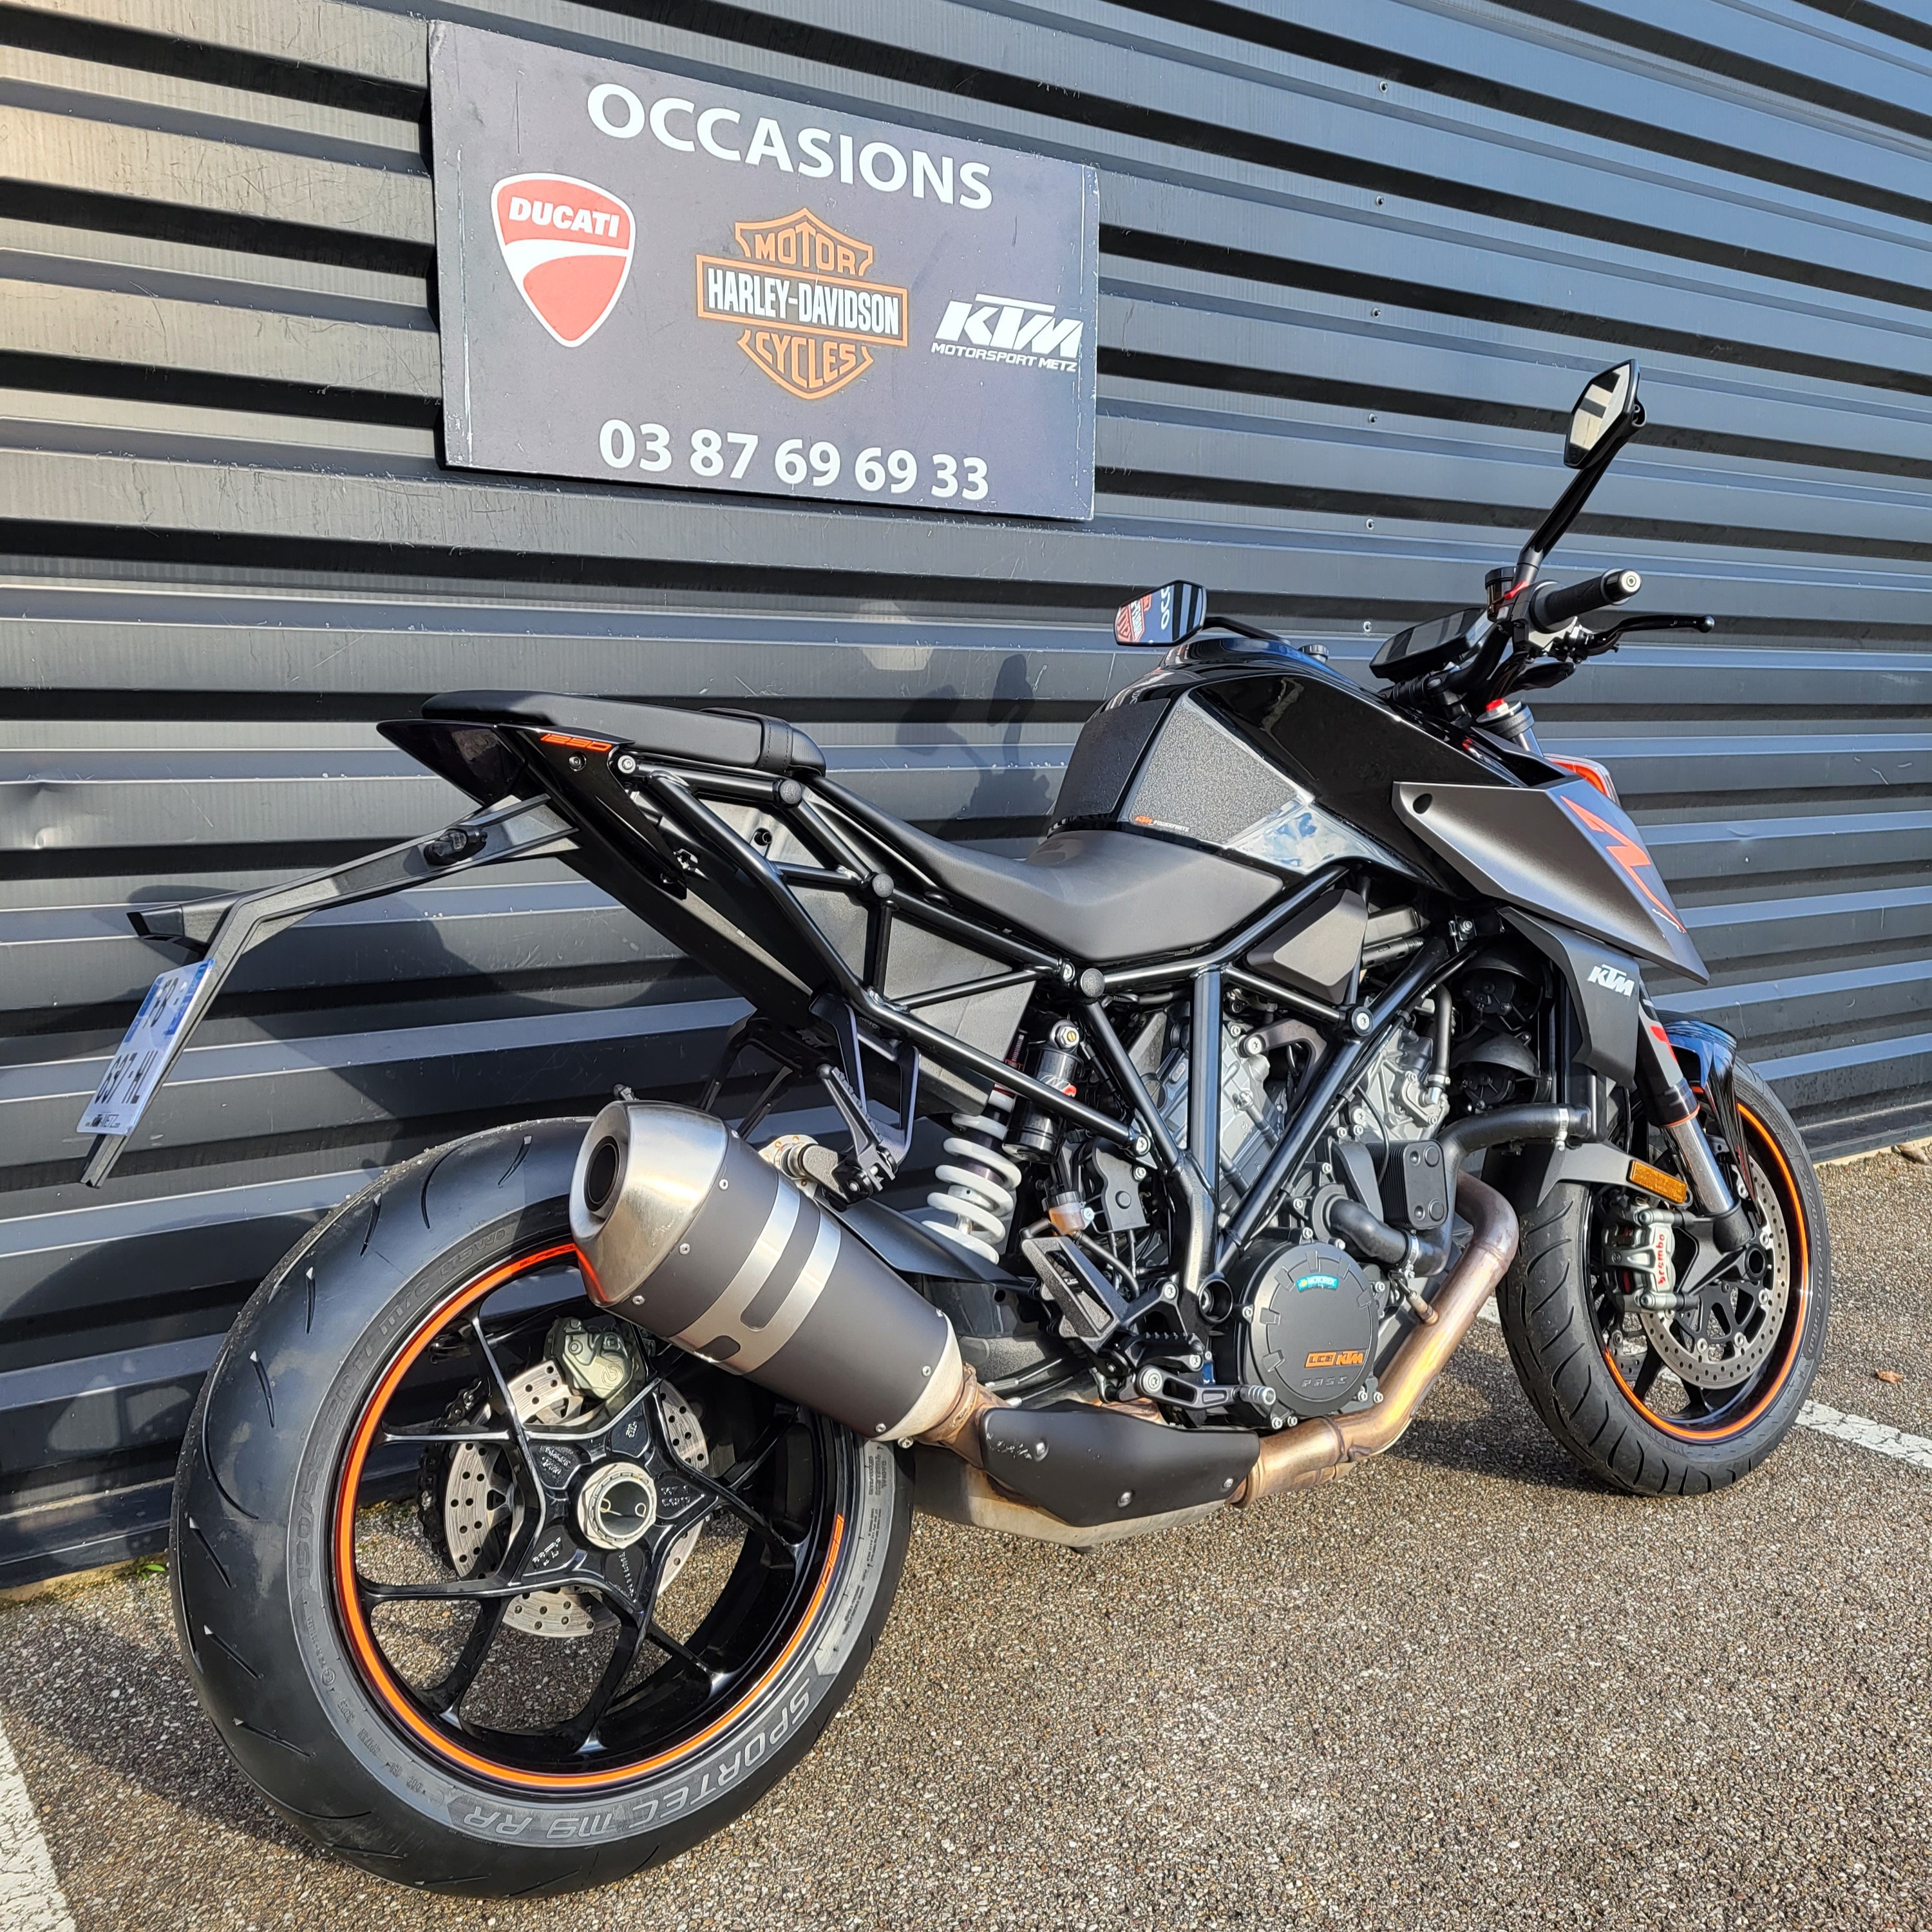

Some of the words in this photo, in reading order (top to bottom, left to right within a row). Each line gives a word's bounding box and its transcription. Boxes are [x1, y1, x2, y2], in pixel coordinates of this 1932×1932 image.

[587, 83, 994, 210] OCCASIONS
[508, 196, 620, 238] DUCATI
[754, 221, 856, 275] MOTOR
[708, 267, 899, 335] HARLEY-DAVIDSON
[935, 293, 1084, 359] KTM
[755, 331, 856, 388] CYCLES
[931, 342, 1037, 367] MOTORSPORT
[1037, 357, 1077, 373] METZ
[598, 419, 672, 472] 03
[689, 428, 759, 480] 87
[774, 438, 841, 488] 69
[854, 447, 918, 494] 69
[931, 453, 989, 500] 33
[540, 733, 613, 752] 1290
[1153, 819, 1190, 832] POWERPARTS
[1587, 963, 1635, 997] KTM
[1655, 1233, 1666, 1285] brembo
[1336, 1350, 1364, 1365] KTM
[627, 1677, 811, 1829] SPORTEC
[462, 1804, 534, 1836] RR
[545, 1812, 613, 1840] M9
